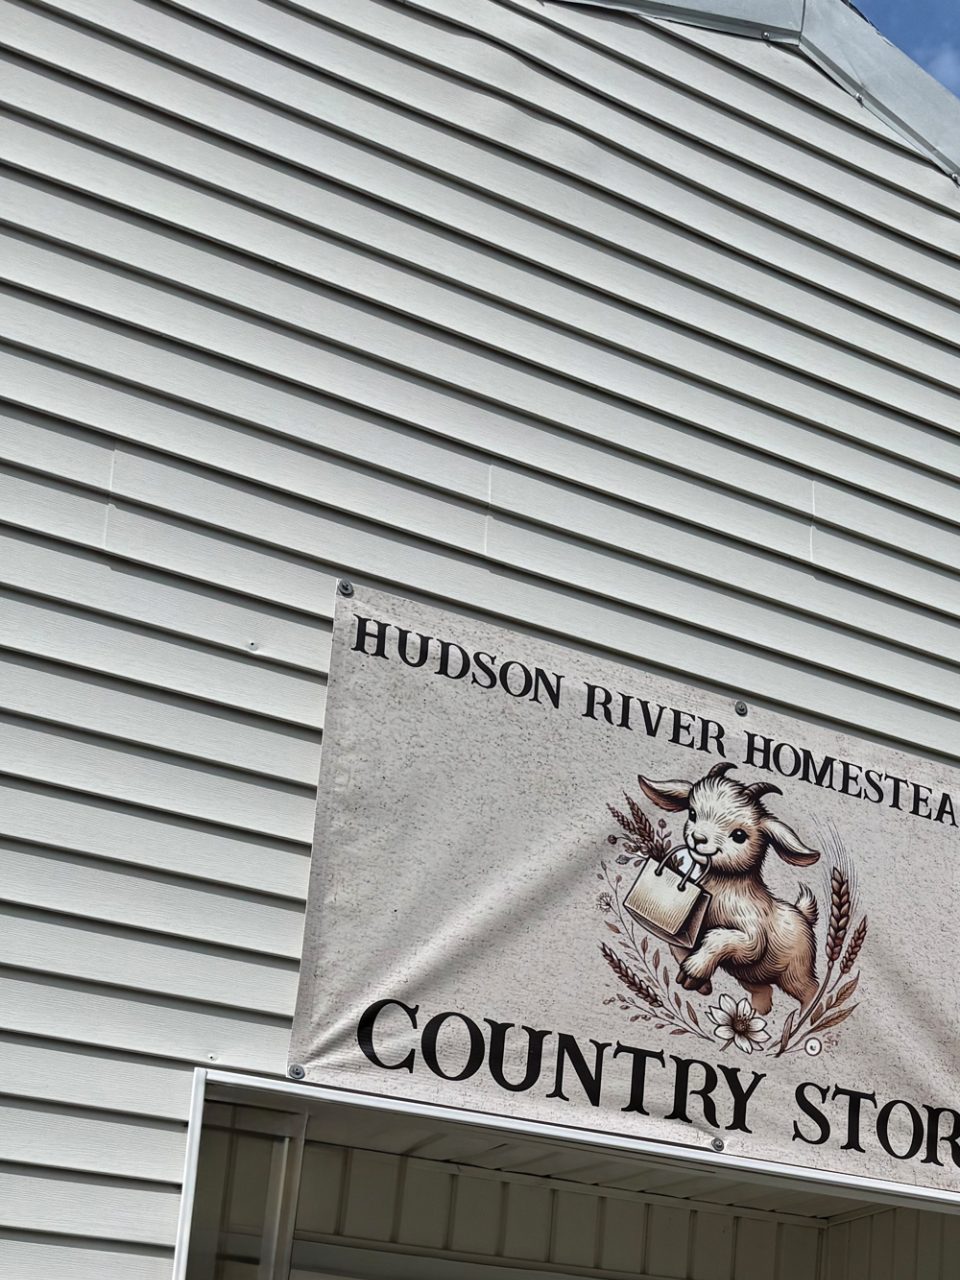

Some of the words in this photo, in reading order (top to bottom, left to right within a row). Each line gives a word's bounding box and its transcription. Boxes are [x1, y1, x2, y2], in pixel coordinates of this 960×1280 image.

[351, 614, 562, 709] HUDSON
[582, 684, 726, 757] RIVER
[356, 998, 767, 1133] COUNTRY
